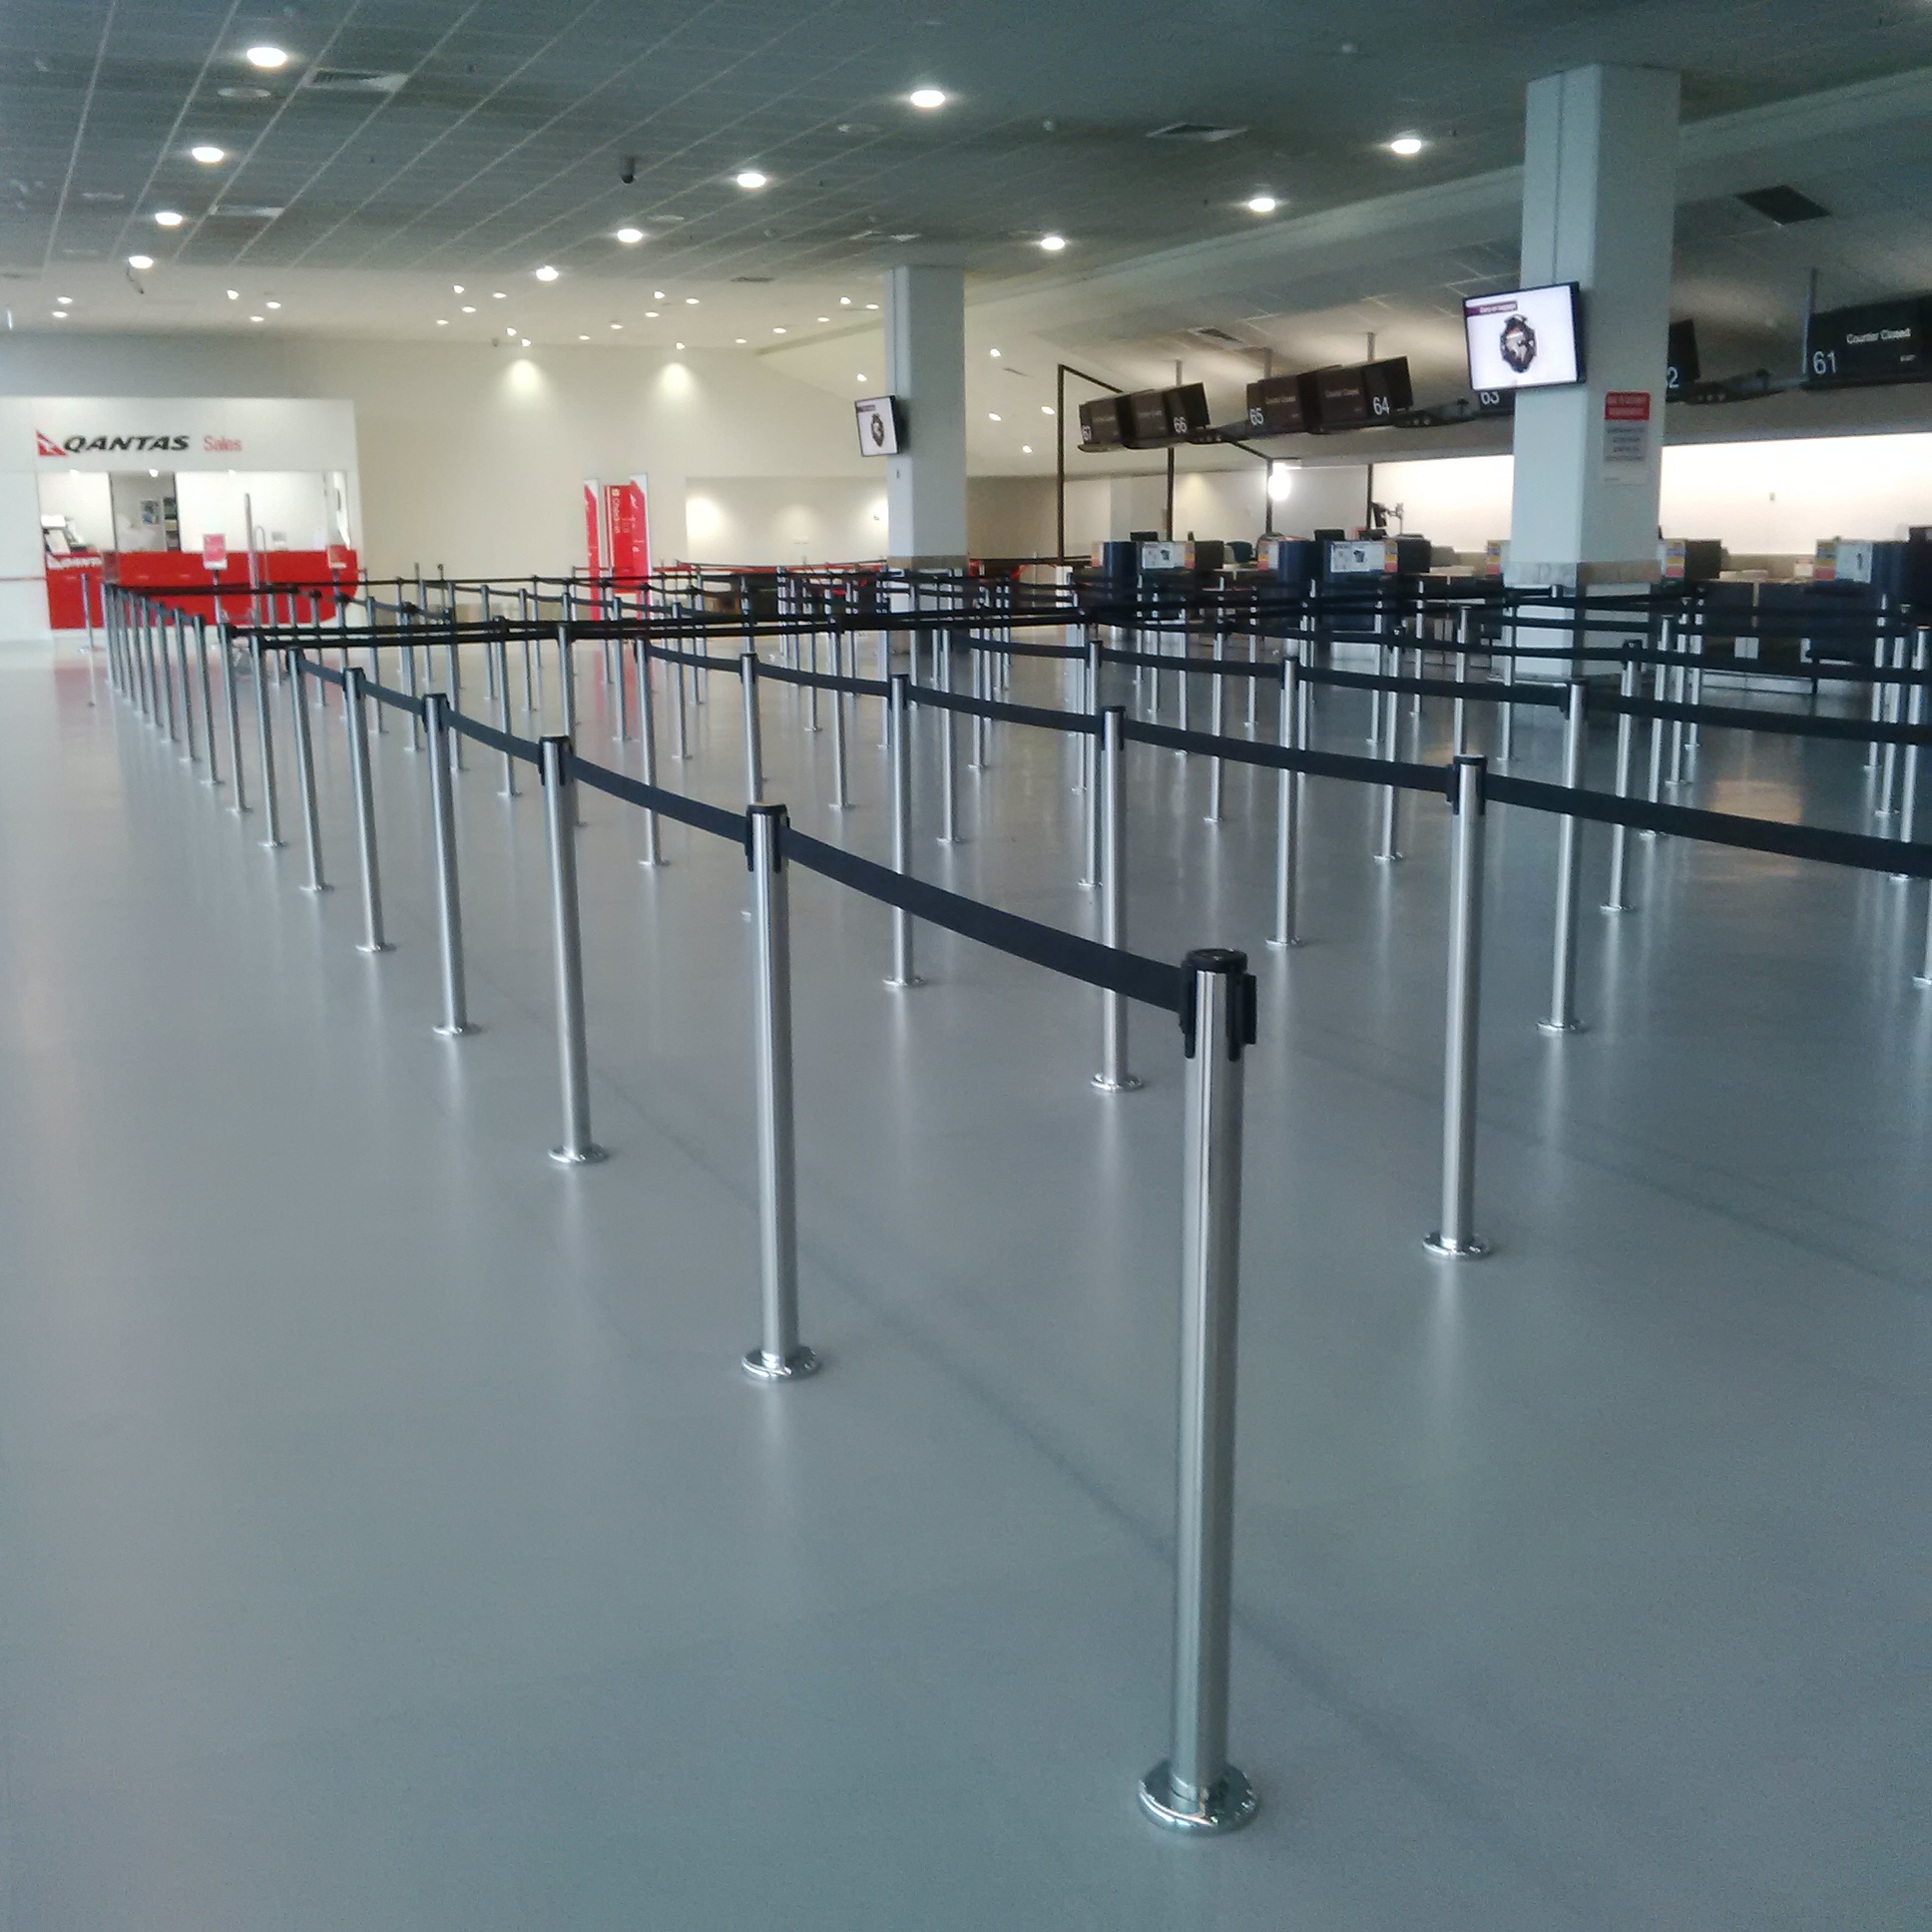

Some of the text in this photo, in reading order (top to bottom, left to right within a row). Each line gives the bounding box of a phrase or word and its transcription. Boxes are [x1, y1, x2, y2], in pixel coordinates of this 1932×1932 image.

[1812, 349, 1836, 375] 61
[1664, 365, 1680, 389] 2
[1372, 396, 1390, 416] 64
[1173, 415, 1188, 433] 66
[1248, 407, 1264, 426] 65
[64, 434, 242, 454] QANTAS Sales
